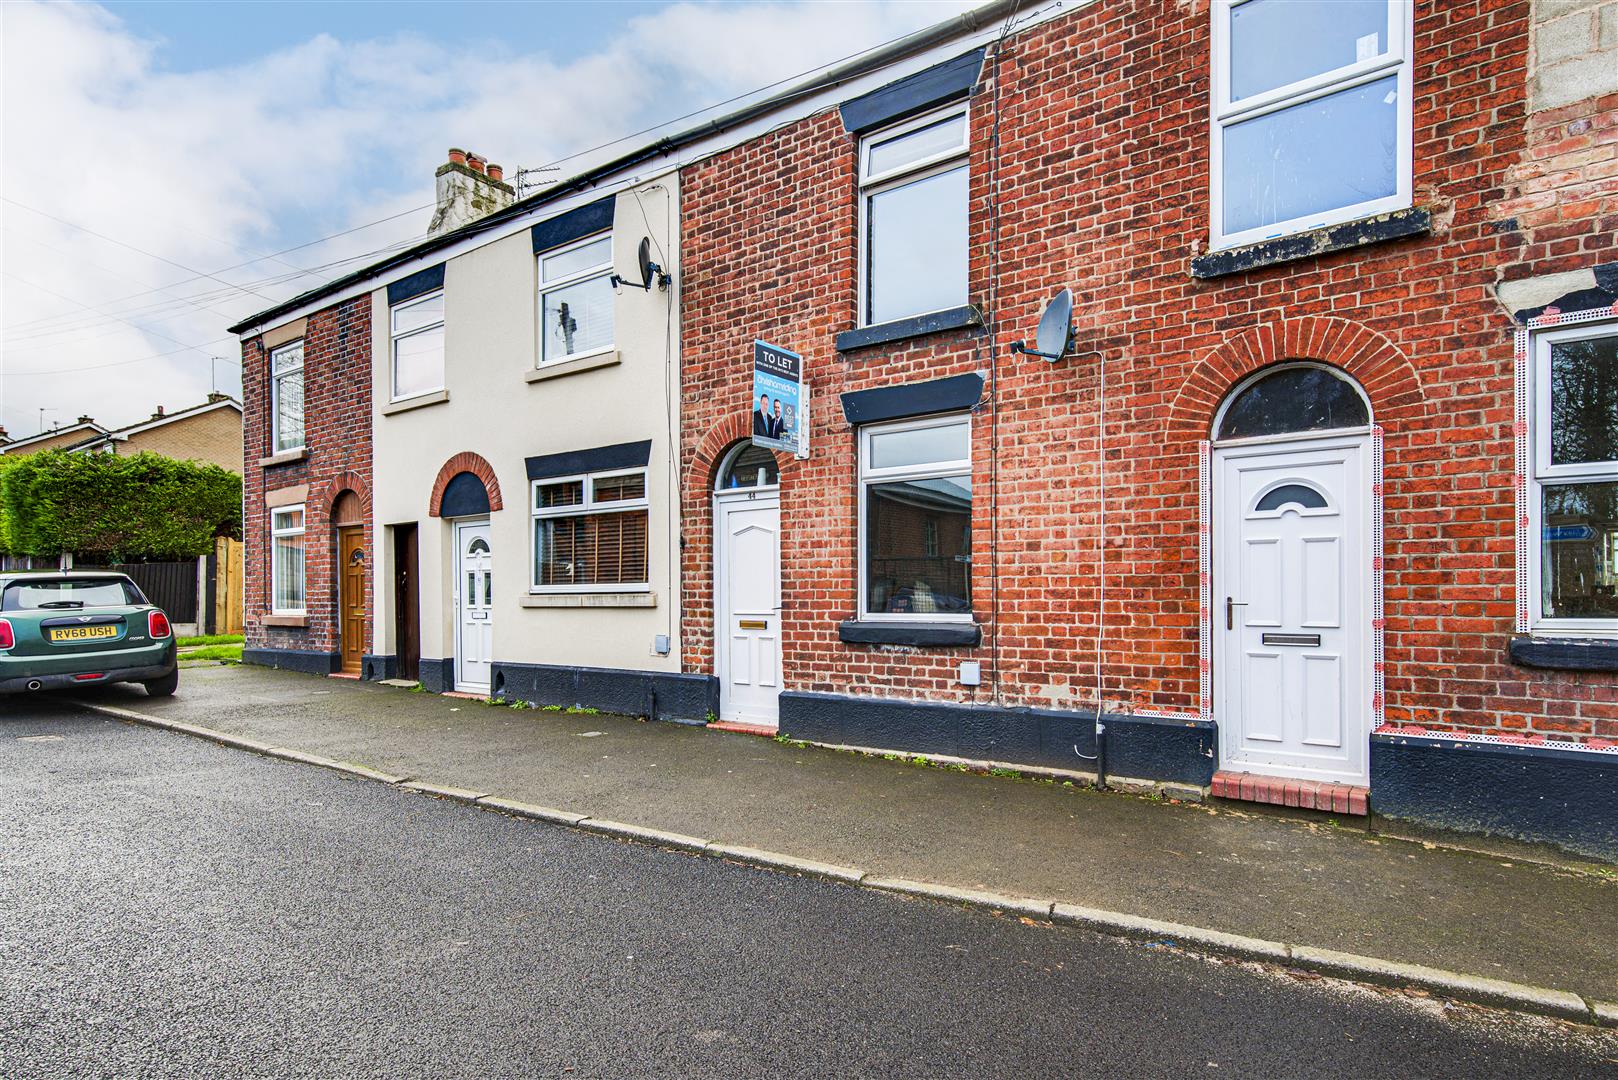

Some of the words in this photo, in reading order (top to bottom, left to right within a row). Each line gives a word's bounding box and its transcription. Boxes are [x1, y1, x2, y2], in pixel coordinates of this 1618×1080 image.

[763, 351, 776, 364] TO
[777, 355, 793, 370] LET
[55, 628, 87, 639] RV68
[90, 627, 112, 637] USH
